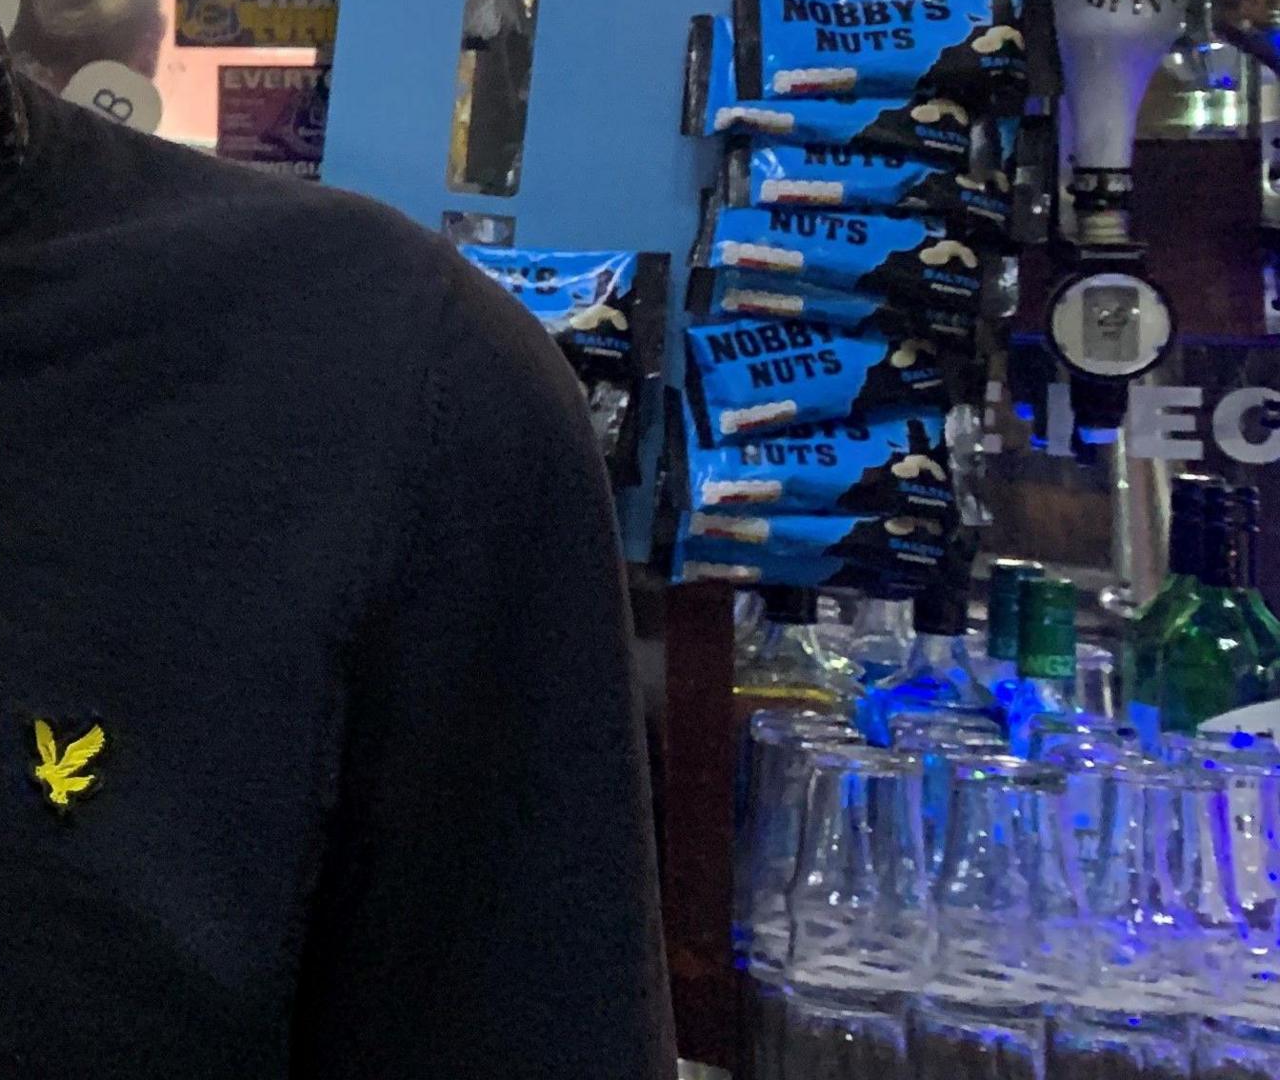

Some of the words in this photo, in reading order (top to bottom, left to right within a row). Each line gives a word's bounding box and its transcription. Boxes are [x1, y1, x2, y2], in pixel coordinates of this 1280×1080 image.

[816, 27, 916, 53] NUTS
[768, 207, 869, 246] NUTS
[748, 348, 843, 389] NUTS
[741, 442, 838, 468] NUTS
